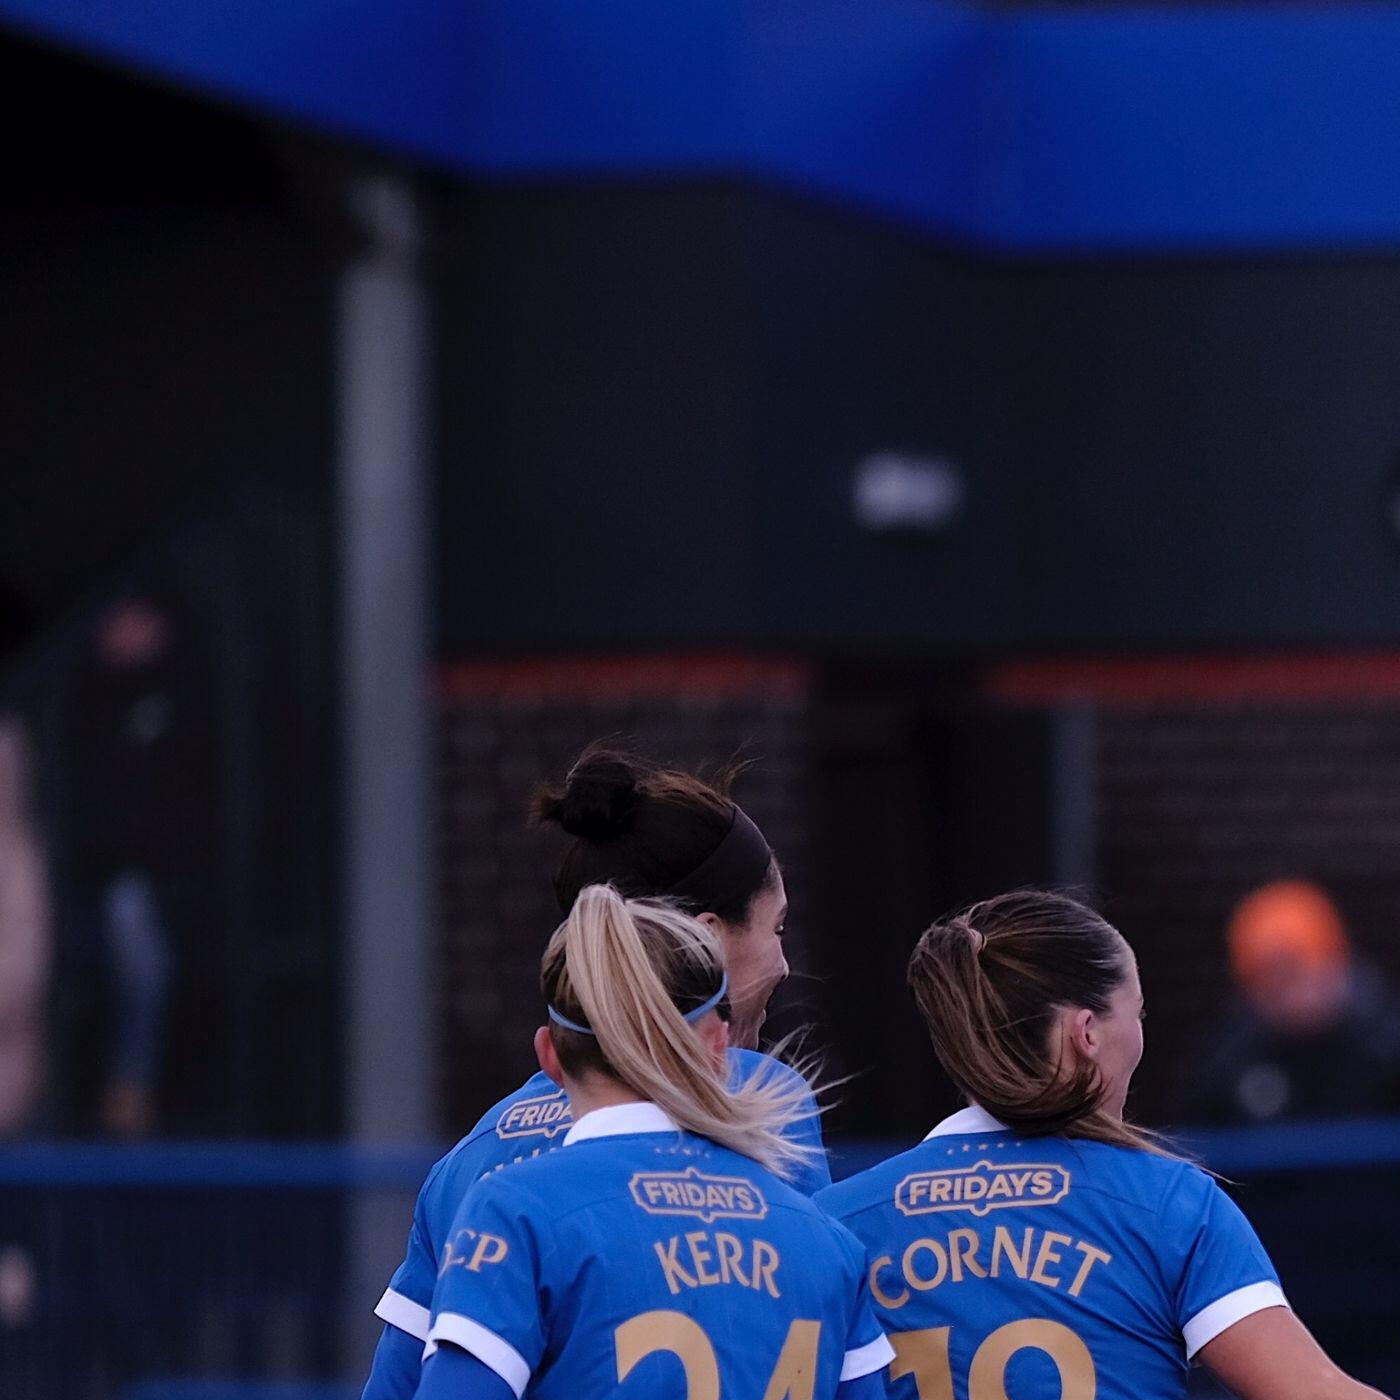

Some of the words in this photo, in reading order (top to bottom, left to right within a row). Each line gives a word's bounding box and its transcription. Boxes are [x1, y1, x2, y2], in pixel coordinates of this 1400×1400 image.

[505, 1101, 574, 1129] FRIDA
[643, 1182, 755, 1210] FRIDAYS
[909, 1171, 1053, 1205] FRIDAYS
[438, 1228, 509, 1278] CP
[653, 1231, 781, 1298] KERR
[869, 1226, 1112, 1309] CORNET
